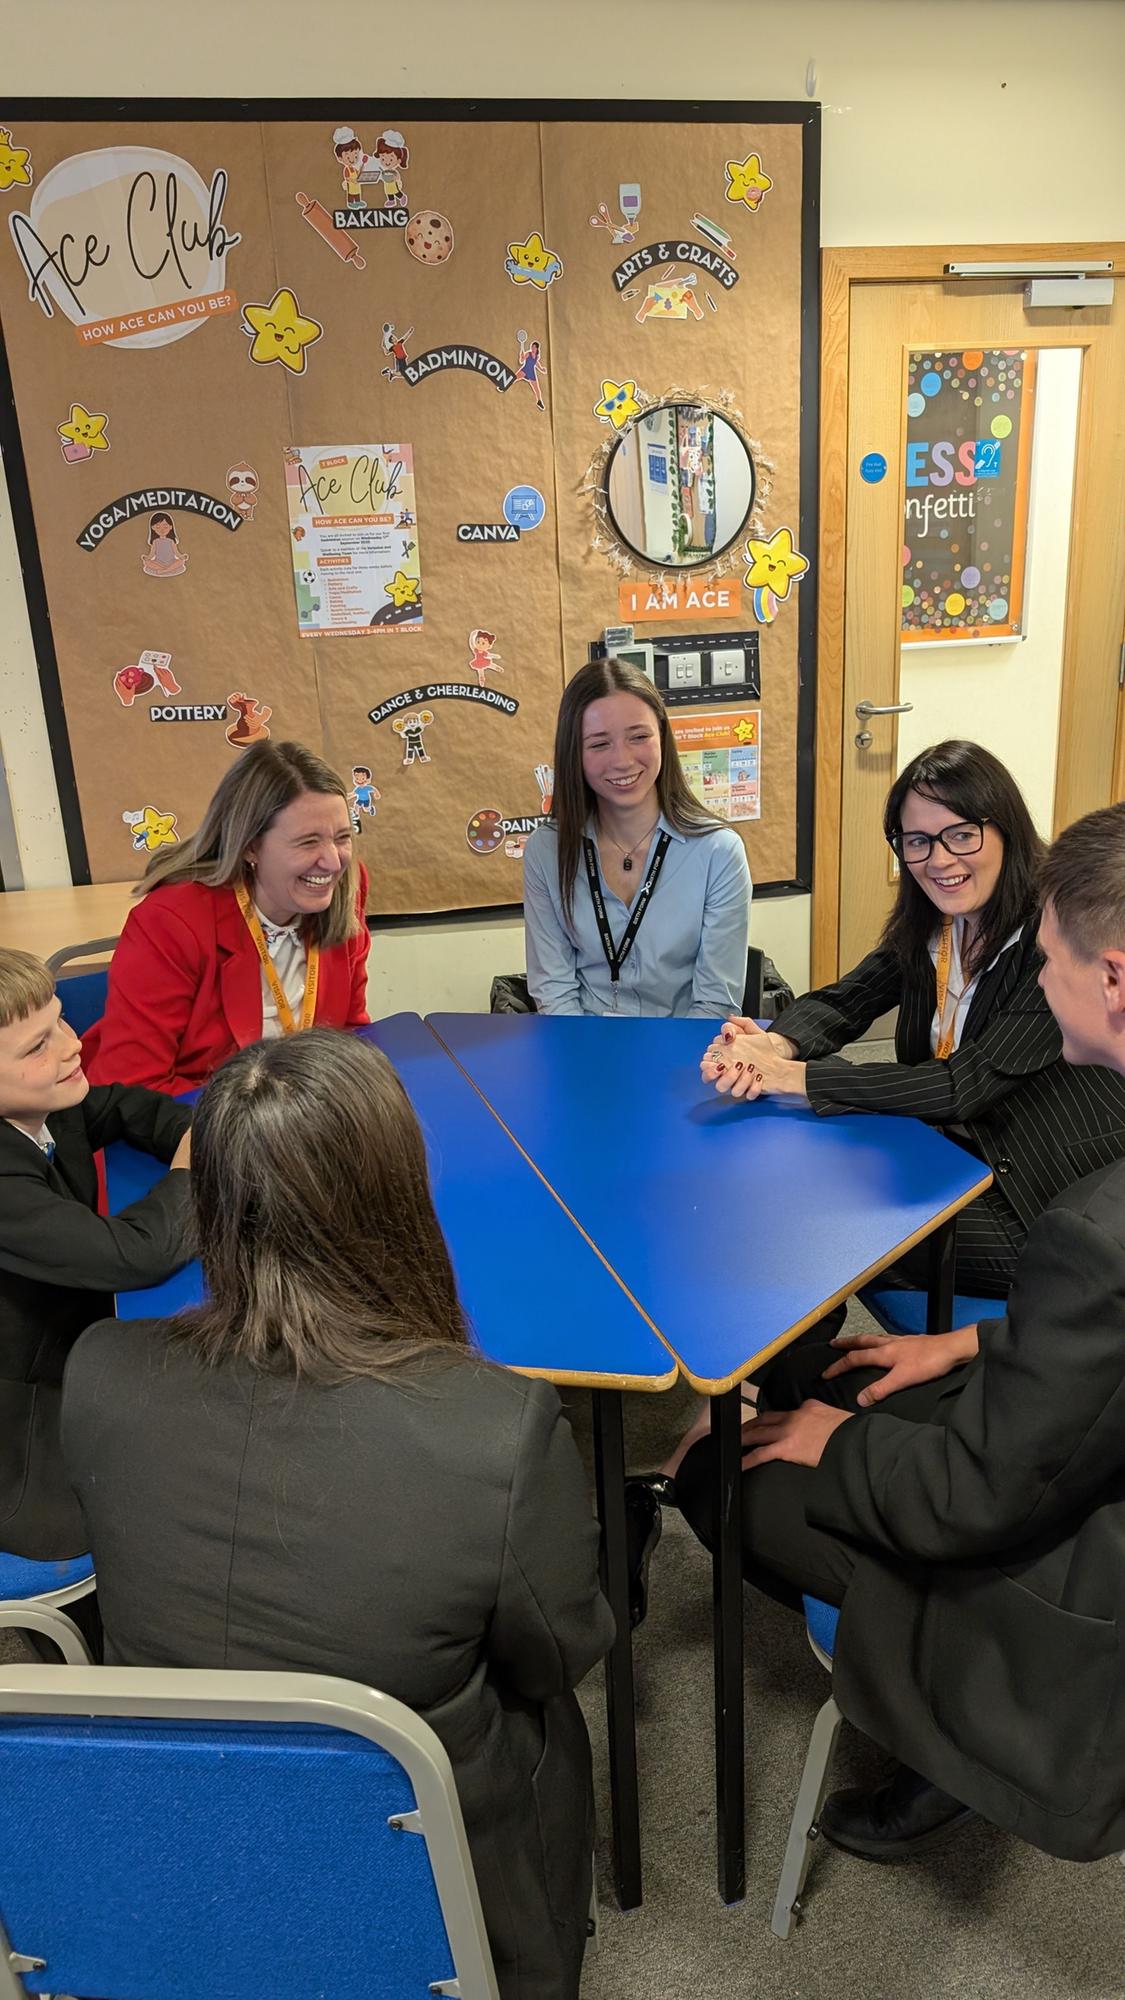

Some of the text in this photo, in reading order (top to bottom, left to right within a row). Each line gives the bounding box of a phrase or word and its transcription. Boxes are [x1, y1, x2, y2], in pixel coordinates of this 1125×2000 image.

[335, 210, 409, 228] BAKING
[12, 171, 240, 316] Ace Club
[615, 243, 736, 287] ARTS & CRAFTS
[82, 295, 232, 341] HOW ACE CAN YOU BE?
[404, 351, 514, 389] BADMINTON
[298, 455, 403, 515] Ace Club
[80, 490, 241, 549] YOGA/MEDITATION
[458, 525, 519, 540] CANVA
[904, 492, 976, 538] nfetti
[631, 591, 730, 611] I AM ACE
[151, 705, 226, 721] POTTERY
[370, 685, 516, 722] DANCE & CHEERLEADING
[256, 935, 270, 965] VISITOR
[271, 981, 286, 1010] VISITOR
[308, 964, 316, 996] VISITOR
